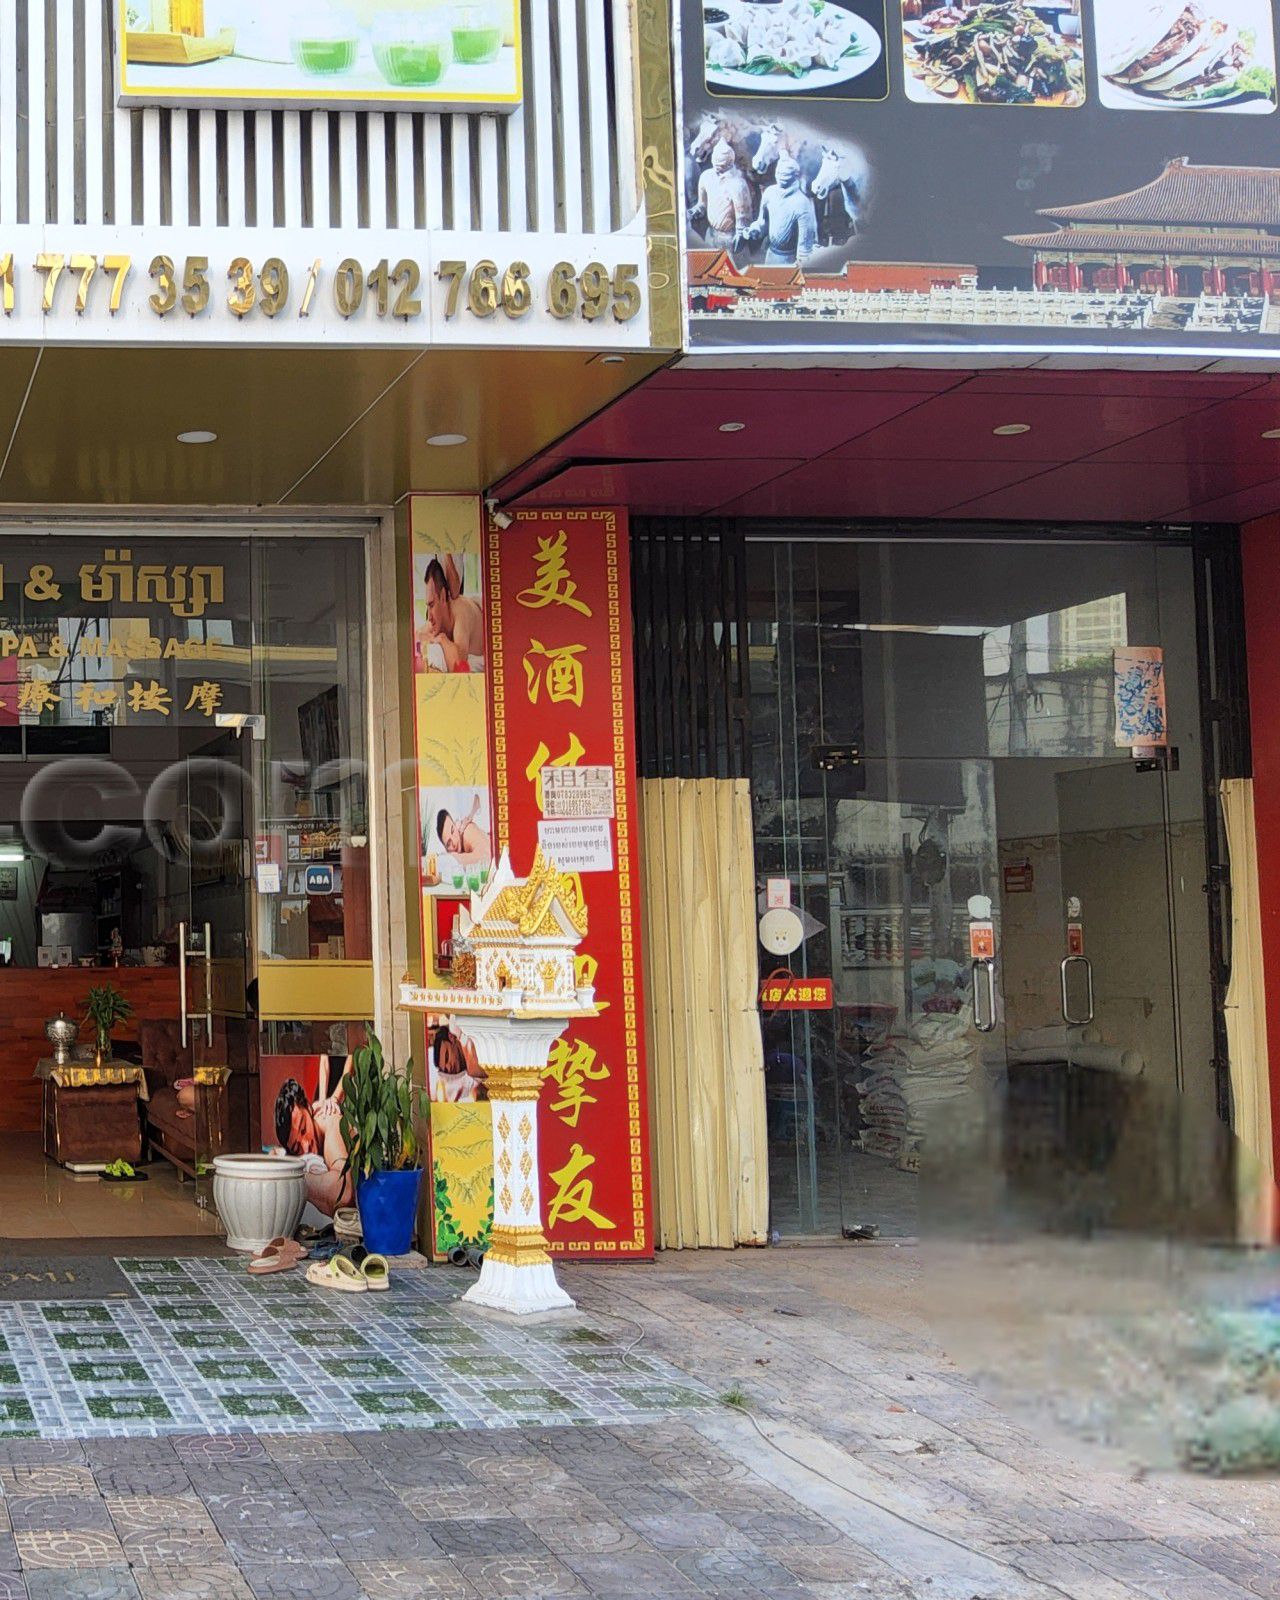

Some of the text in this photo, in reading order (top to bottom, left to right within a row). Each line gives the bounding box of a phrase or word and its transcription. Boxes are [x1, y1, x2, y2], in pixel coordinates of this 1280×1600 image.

[35, 253, 131, 313] 777
[148, 255, 210, 316] 35
[437, 260, 532, 319] 766
[548, 261, 639, 321] 695
[24, 565, 62, 602] &
[49, 636, 70, 658] &
[80, 637, 224, 659] MASSAGE
[544, 769, 612, 788] 租售
[308, 874, 330, 885] ABA
[972, 929, 992, 938] PULL
